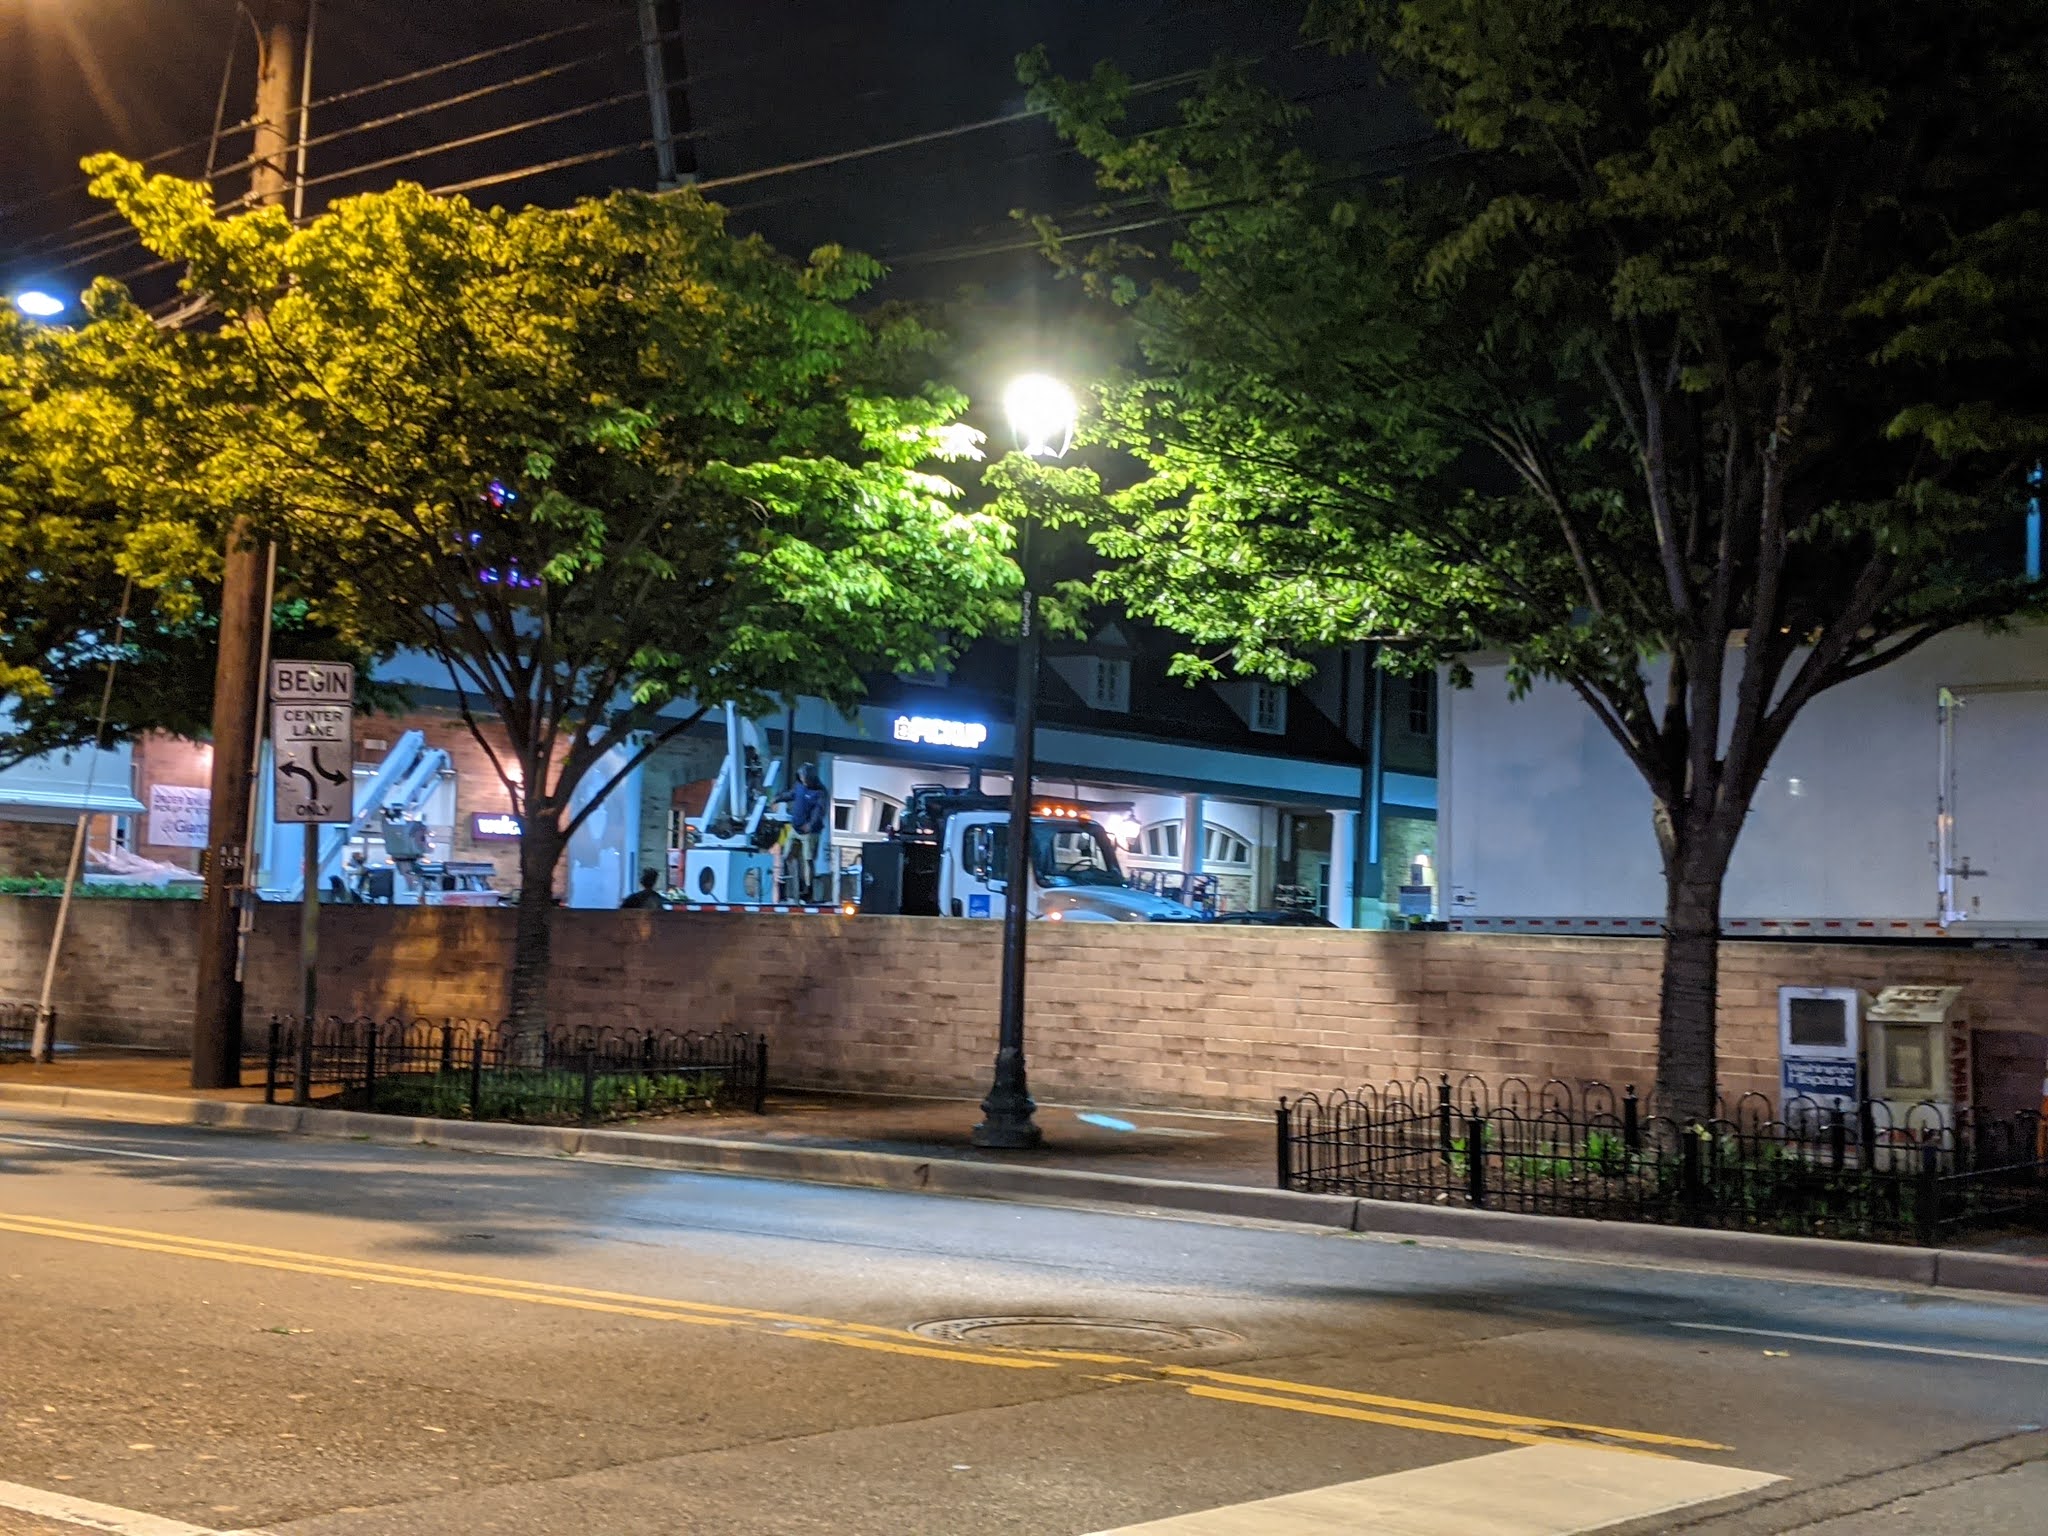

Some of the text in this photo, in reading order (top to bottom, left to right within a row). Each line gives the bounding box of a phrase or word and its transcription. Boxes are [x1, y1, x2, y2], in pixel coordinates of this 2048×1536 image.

[277, 669, 348, 694] BEGIN
[283, 710, 343, 722] CENTER
[292, 725, 335, 738] LANE
[295, 803, 334, 817] ONLY
[1787, 1071, 1854, 1087] Hispanic
